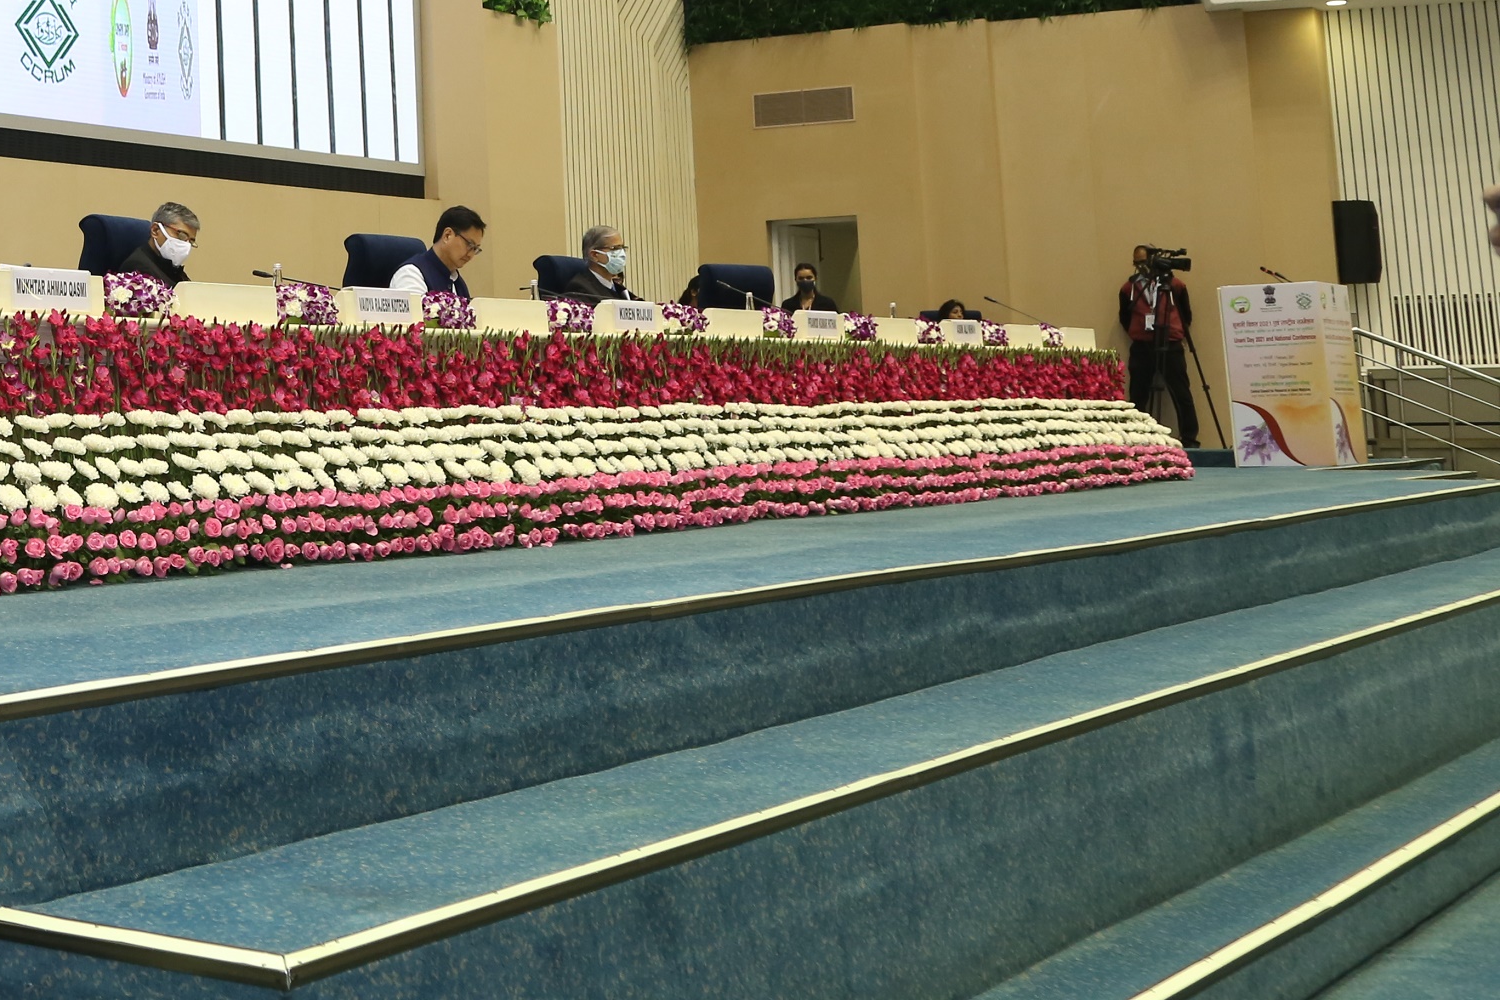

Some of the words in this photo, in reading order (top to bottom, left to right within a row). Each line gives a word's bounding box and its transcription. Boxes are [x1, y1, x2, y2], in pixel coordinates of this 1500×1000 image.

[20, 51, 76, 83] CCRUM
[16, 278, 46, 295] MUKHTAR
[47, 280, 68, 296] AHMAD
[68, 282, 87, 297] QASMI
[620, 308, 636, 320] KIREN
